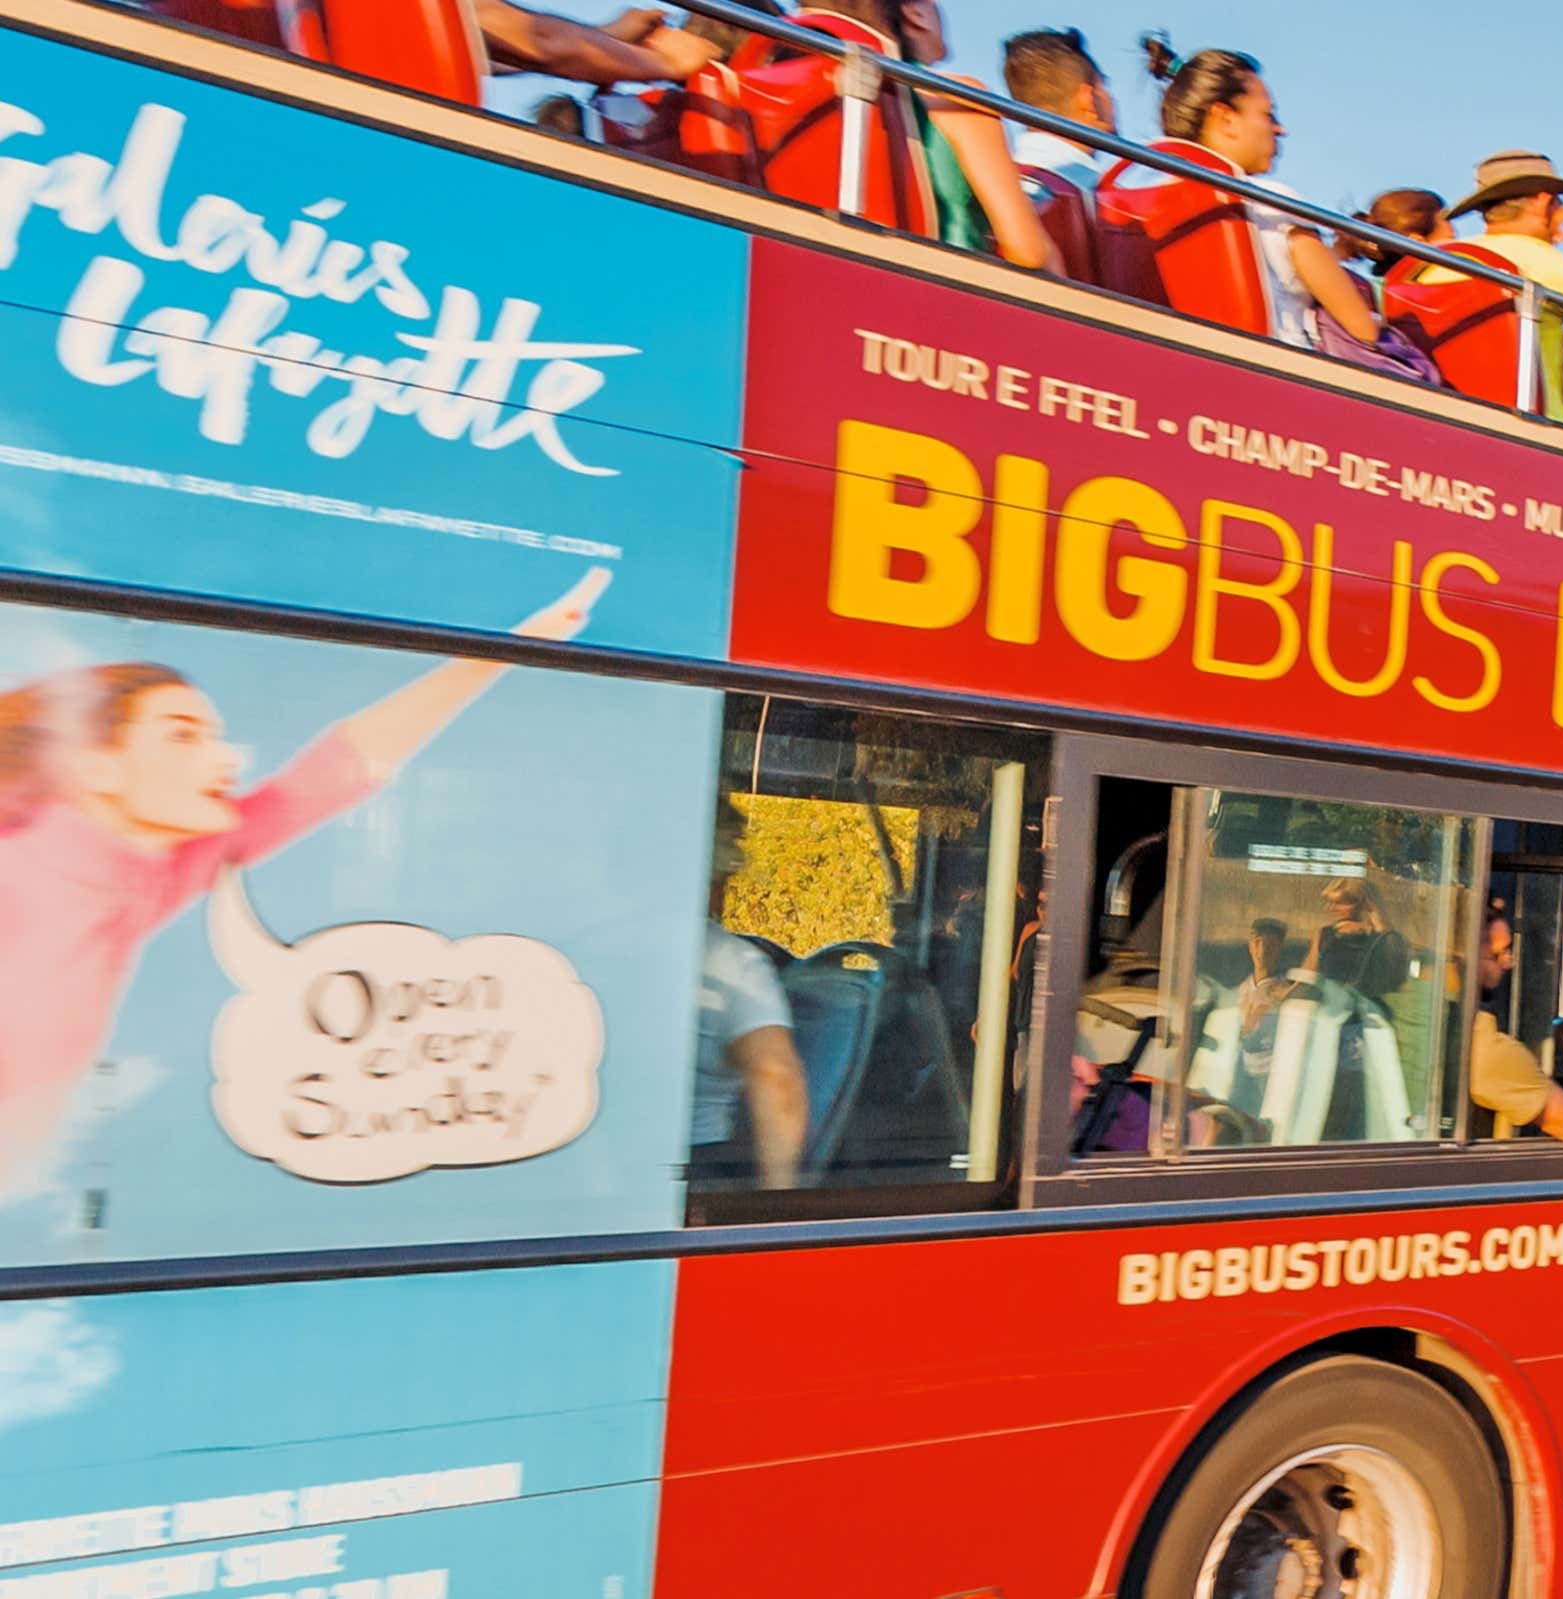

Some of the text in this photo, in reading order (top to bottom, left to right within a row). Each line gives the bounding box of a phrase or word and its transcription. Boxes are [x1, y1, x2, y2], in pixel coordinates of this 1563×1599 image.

[56, 255, 644, 477] Lafayette
[853, 328, 989, 400] TOUR
[1188, 415, 1496, 520] CHAMP-DE-MARS
[358, 1029, 515, 1079] eery
